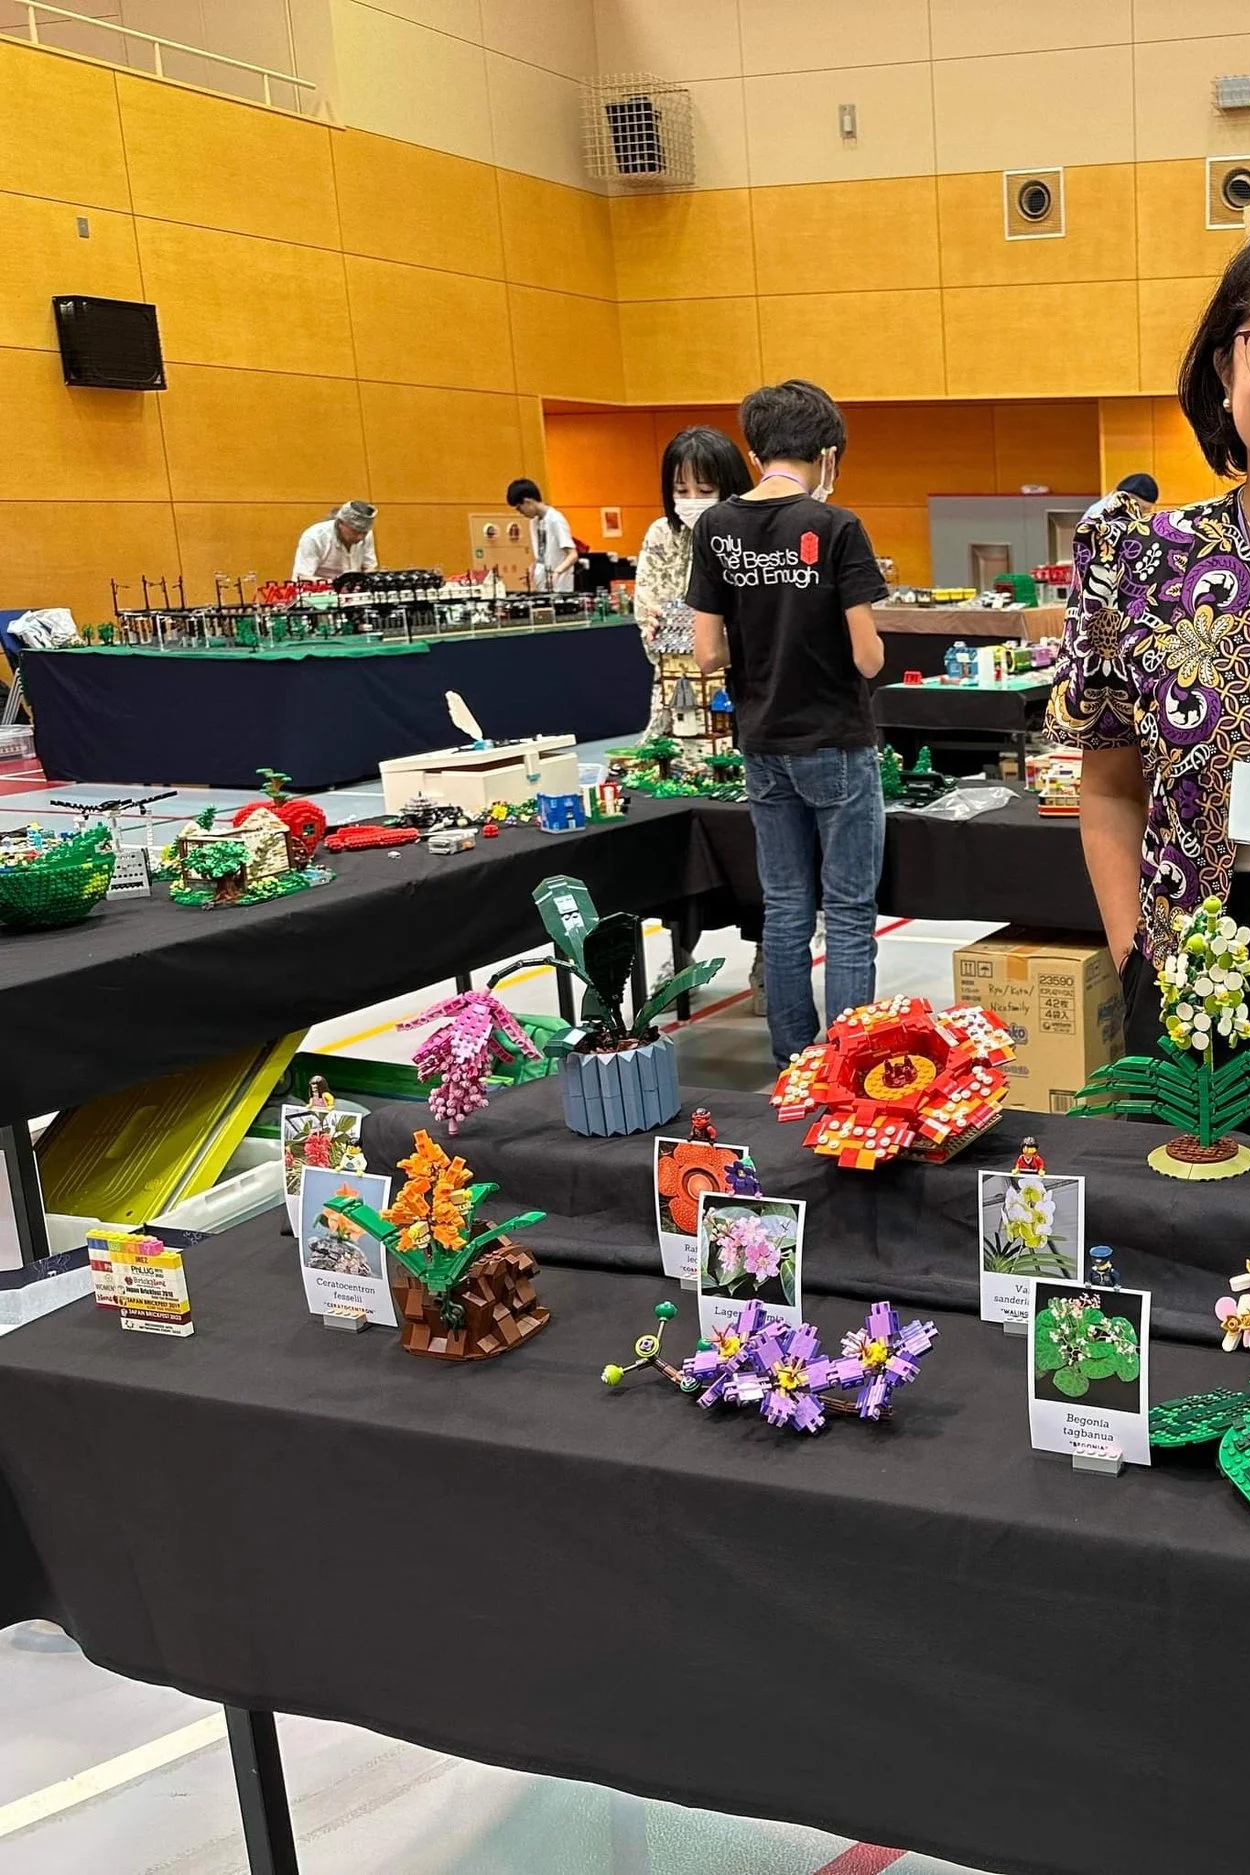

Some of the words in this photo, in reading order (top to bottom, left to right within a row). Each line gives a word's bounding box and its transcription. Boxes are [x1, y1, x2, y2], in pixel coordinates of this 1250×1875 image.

[710, 534, 742, 557] Only
[743, 550, 785, 569] Best
[1039, 975, 1074, 987] 23590
[316, 1277, 376, 1294] Ceratocentron
[333, 1291, 363, 1303] fesselii
[1066, 1412, 1110, 1429] Begonia
[1063, 1426, 1114, 1442] tagbanua
